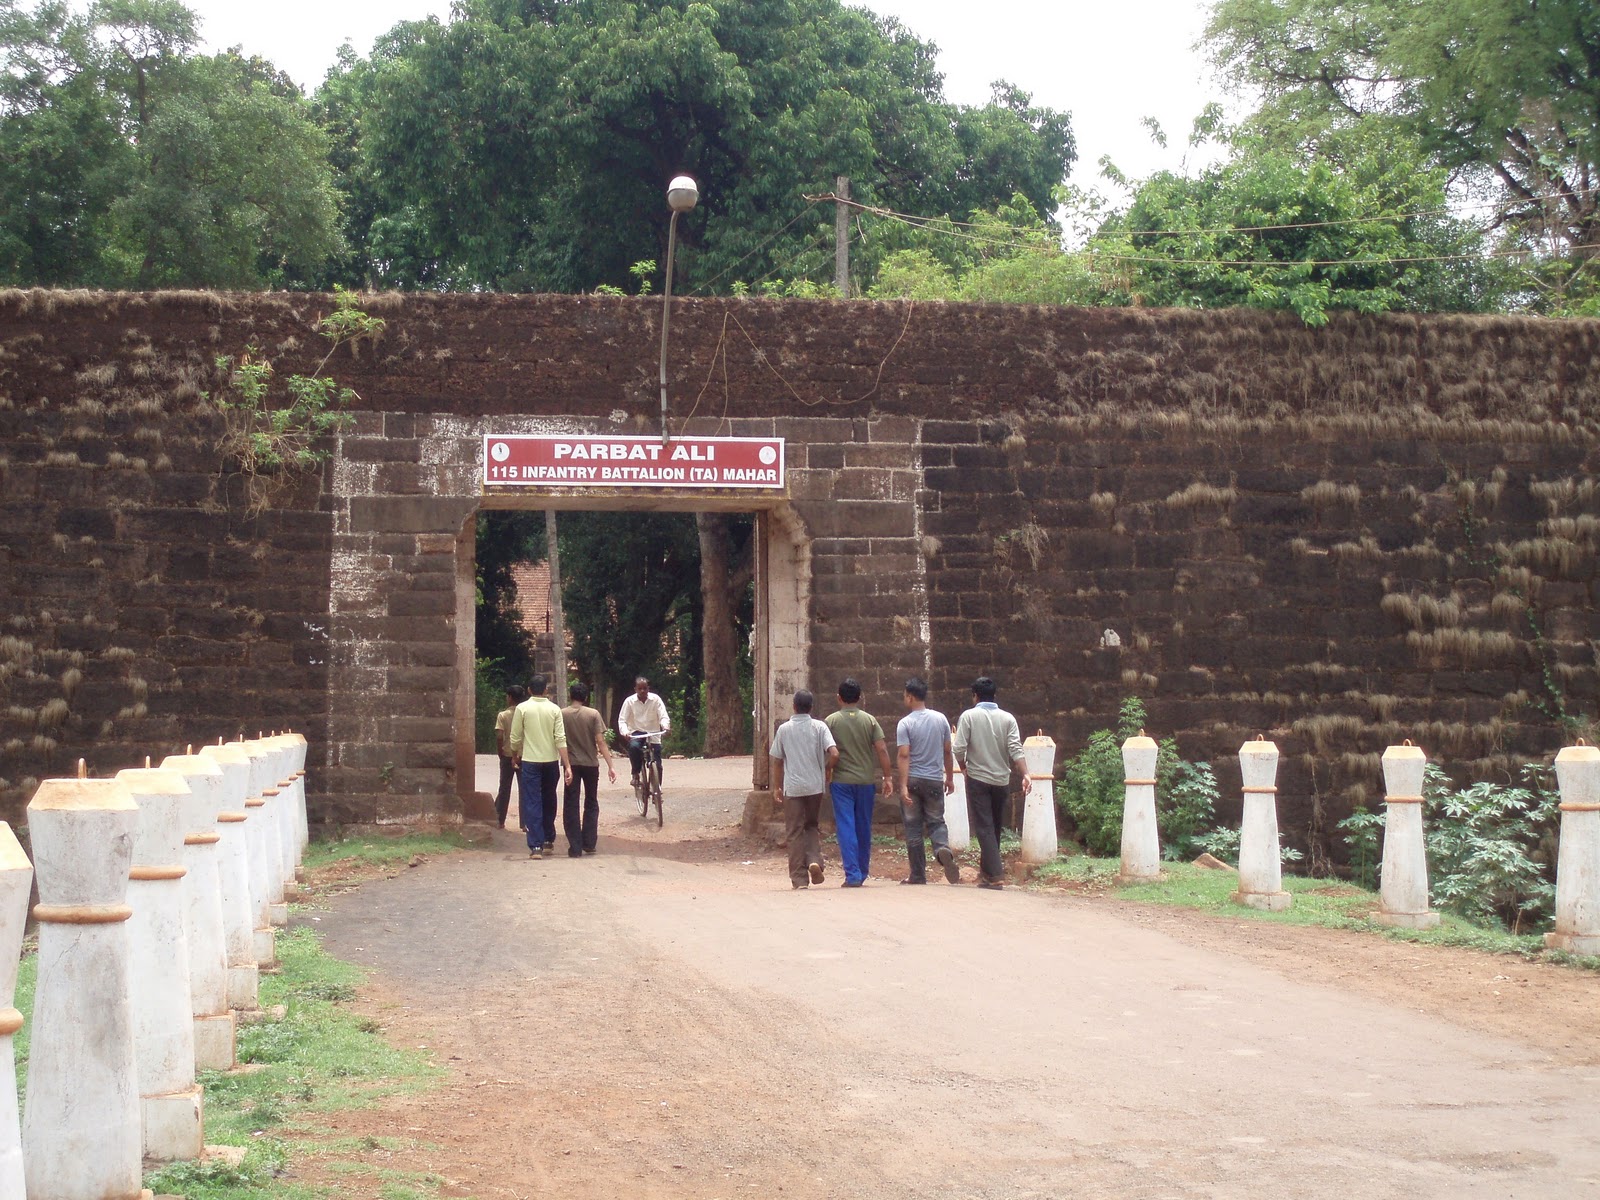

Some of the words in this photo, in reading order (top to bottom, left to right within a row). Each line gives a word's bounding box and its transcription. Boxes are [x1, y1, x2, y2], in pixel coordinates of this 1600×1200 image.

[554, 443, 663, 461] PARBAT
[671, 445, 714, 461] ALI
[491, 466, 518, 478] 115
[522, 466, 596, 479] INFANTRY
[601, 467, 685, 480] BATTALION
[690, 467, 718, 482] (TA)
[723, 468, 777, 481] MAHAR
